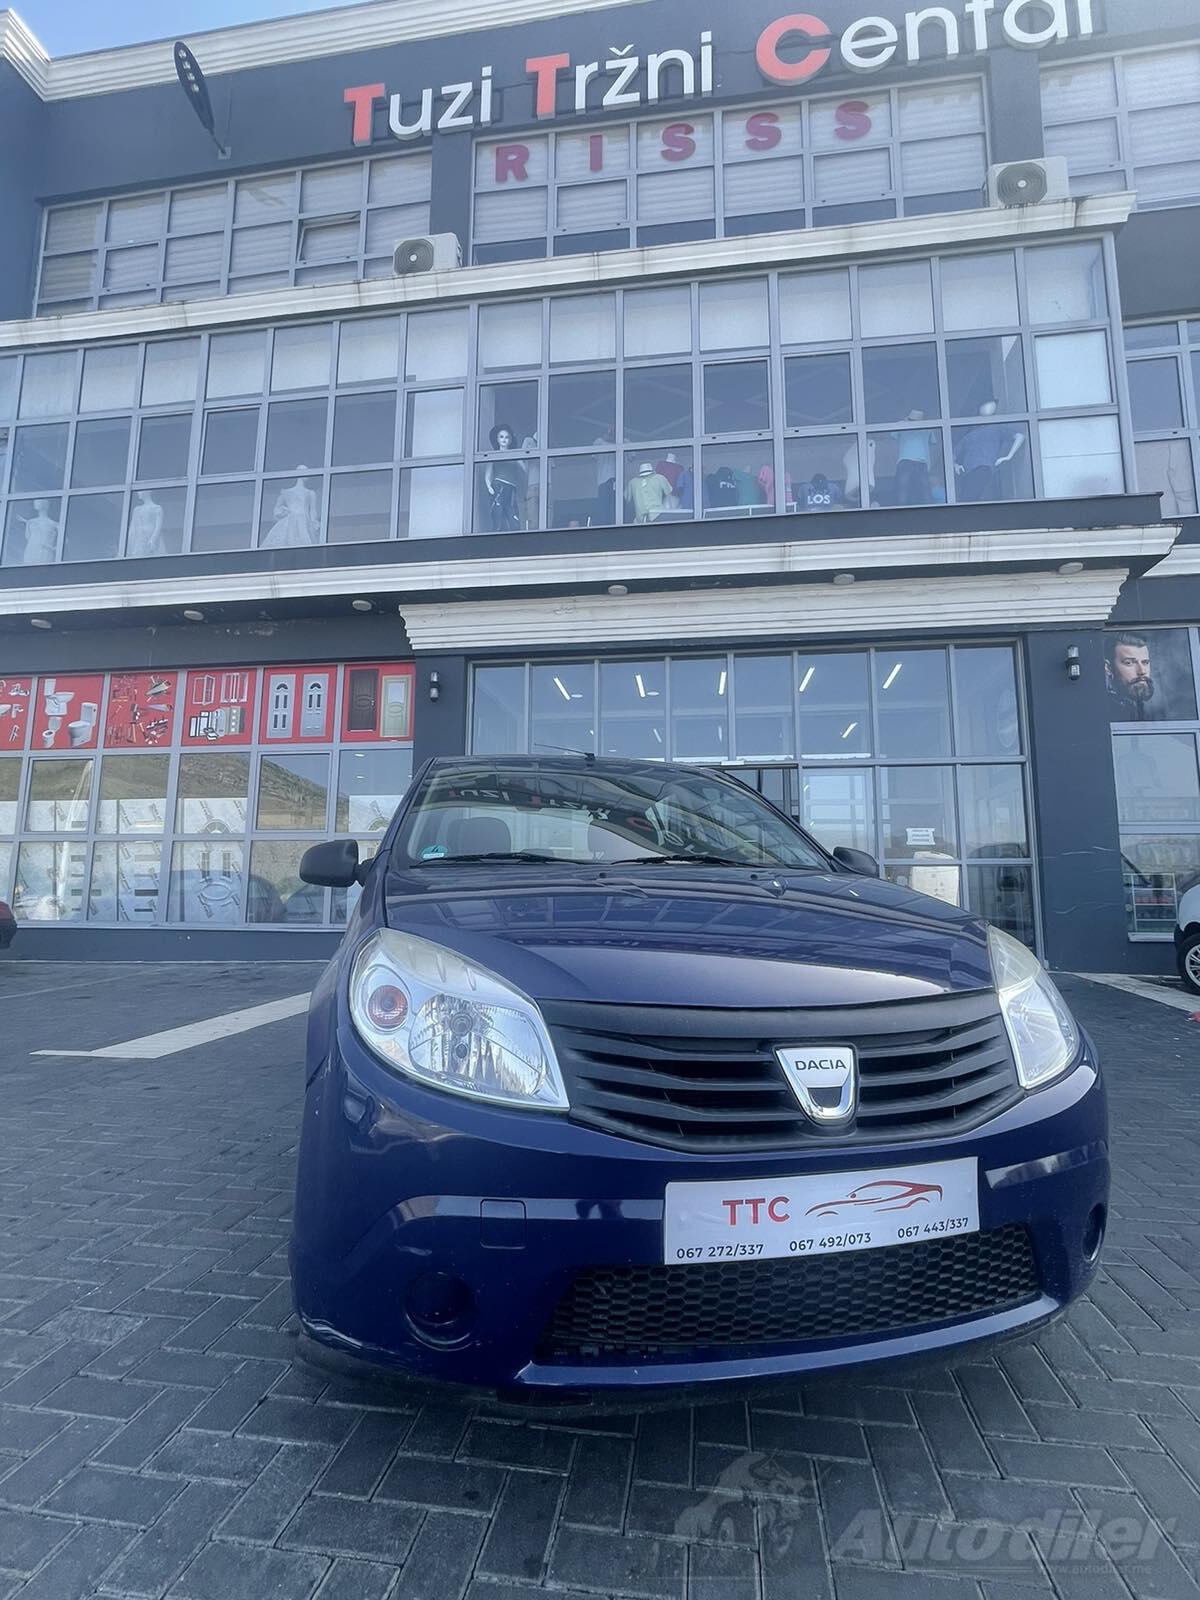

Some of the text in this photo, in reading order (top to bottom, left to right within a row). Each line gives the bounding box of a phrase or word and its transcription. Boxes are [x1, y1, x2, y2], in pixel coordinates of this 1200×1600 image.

[344, 66, 493, 146] Tuzi
[526, 31, 713, 119] Tržni
[795, 1059, 847, 1070] DACIA
[722, 1196, 790, 1226] TTC
[676, 1217, 969, 1259] 067 272/337 067 492/073 067 443/337
